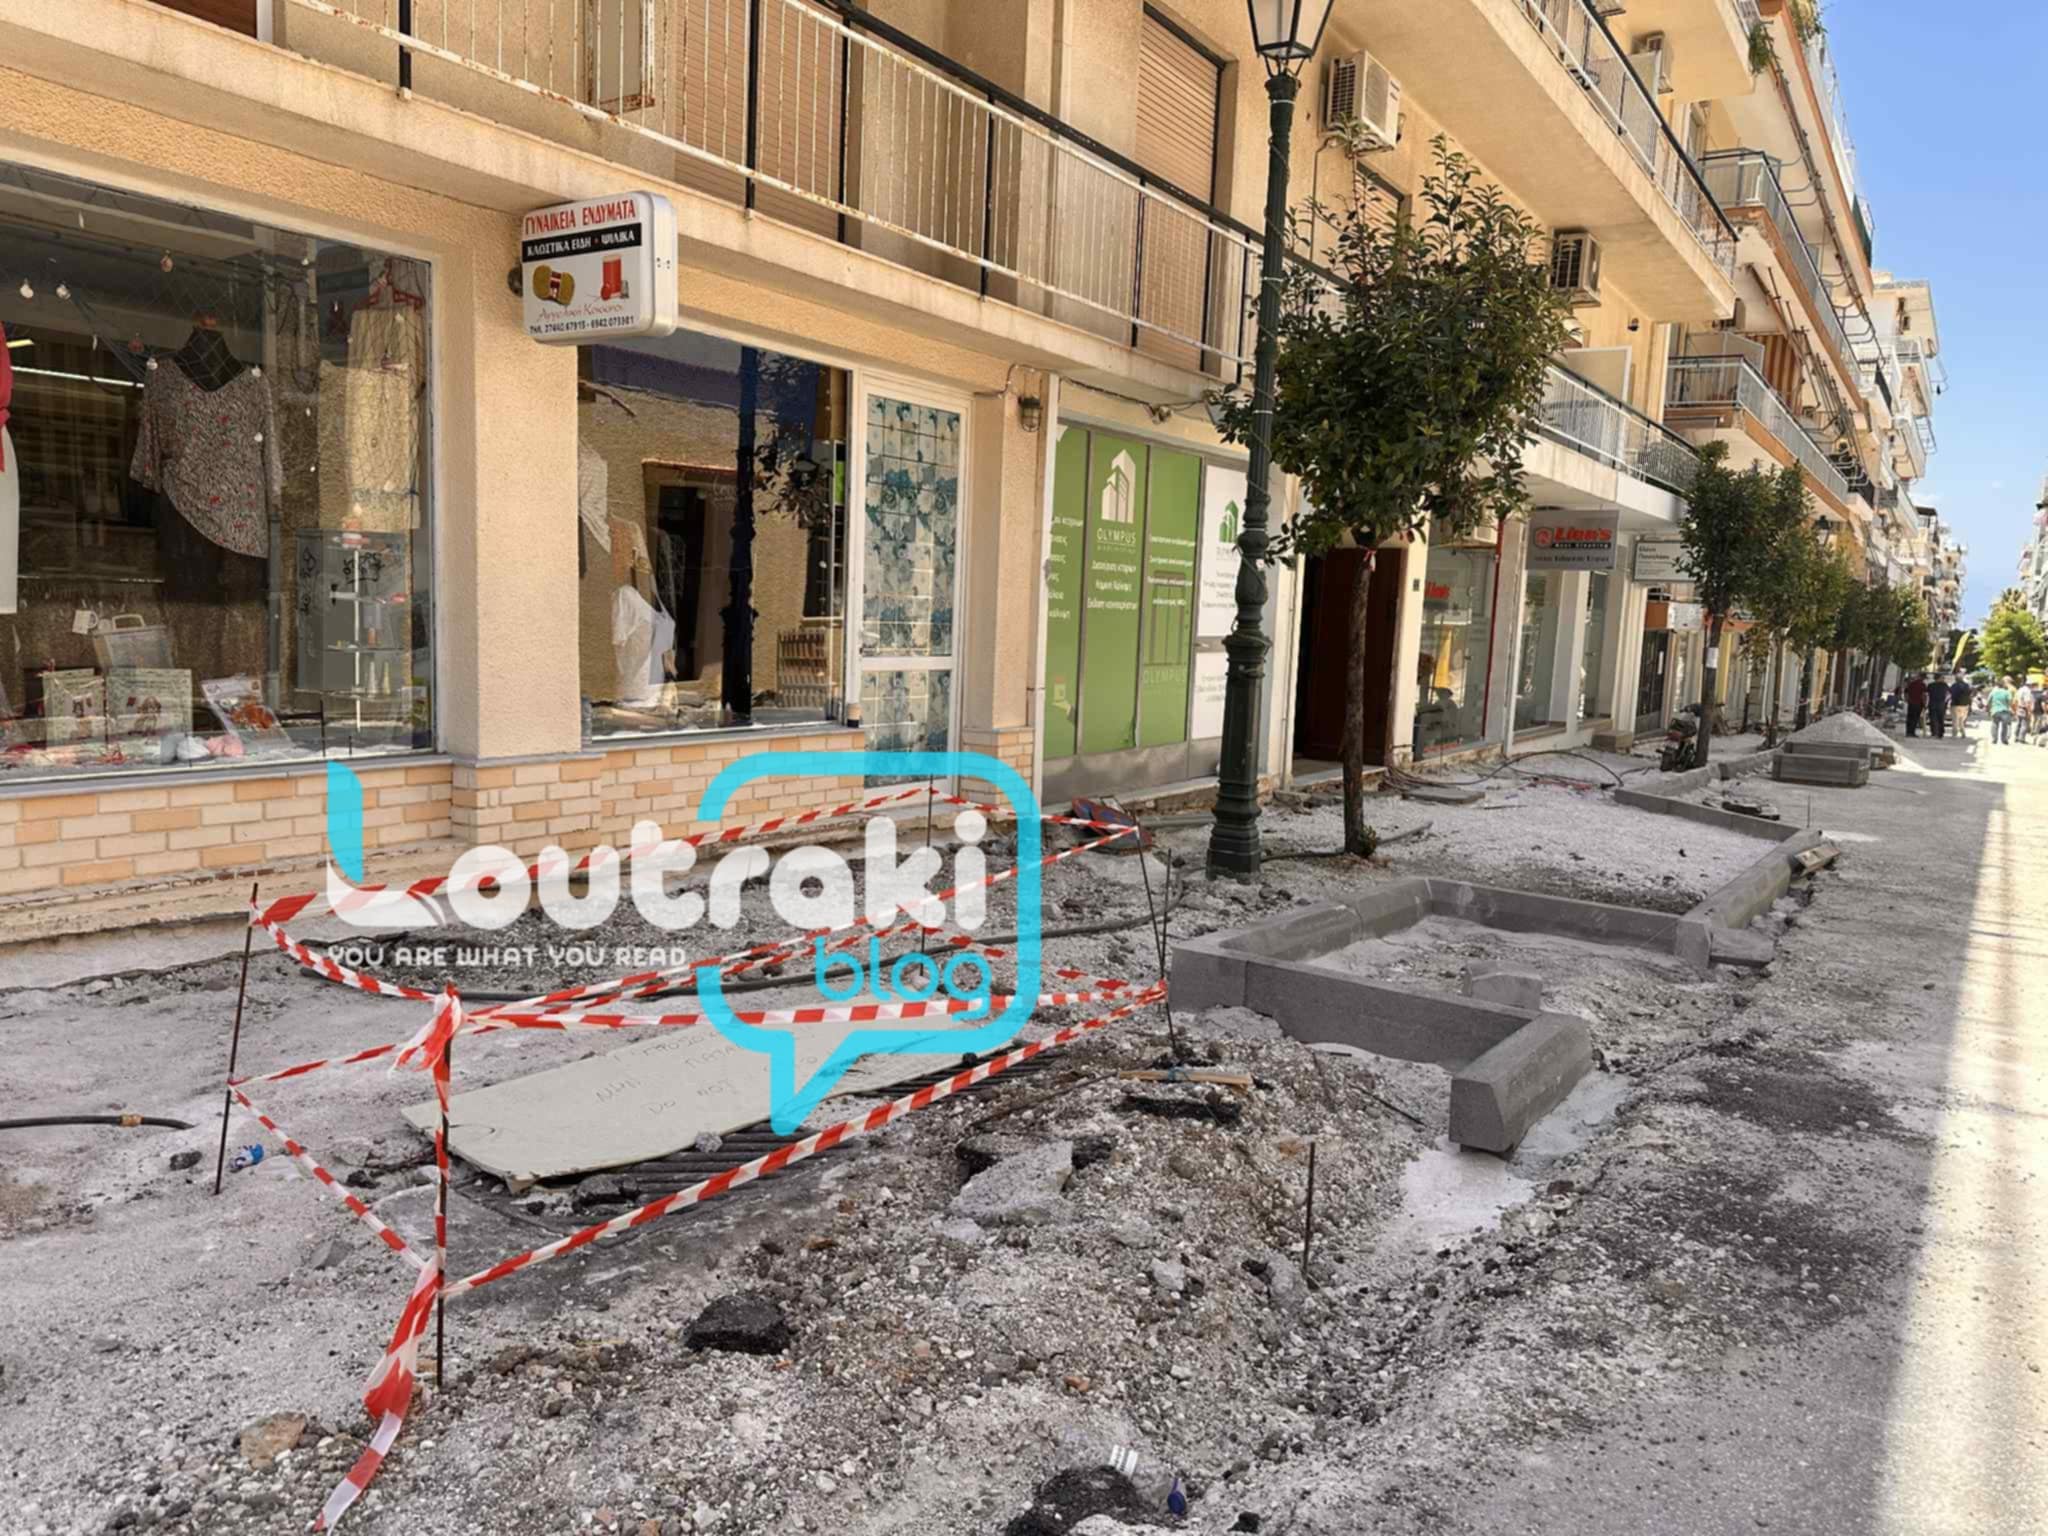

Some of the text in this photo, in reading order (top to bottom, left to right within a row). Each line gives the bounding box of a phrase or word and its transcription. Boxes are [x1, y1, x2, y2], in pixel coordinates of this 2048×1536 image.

[525, 199, 636, 236] ΓΥΝΑΙΚΕΙΑ ΕΝΔΥΜΑΤΑ
[571, 236, 592, 251] ΕΙΔΗ
[600, 229, 635, 246] ΨΙΛΙΚΑ
[1096, 528, 1137, 544] OLYMPUS
